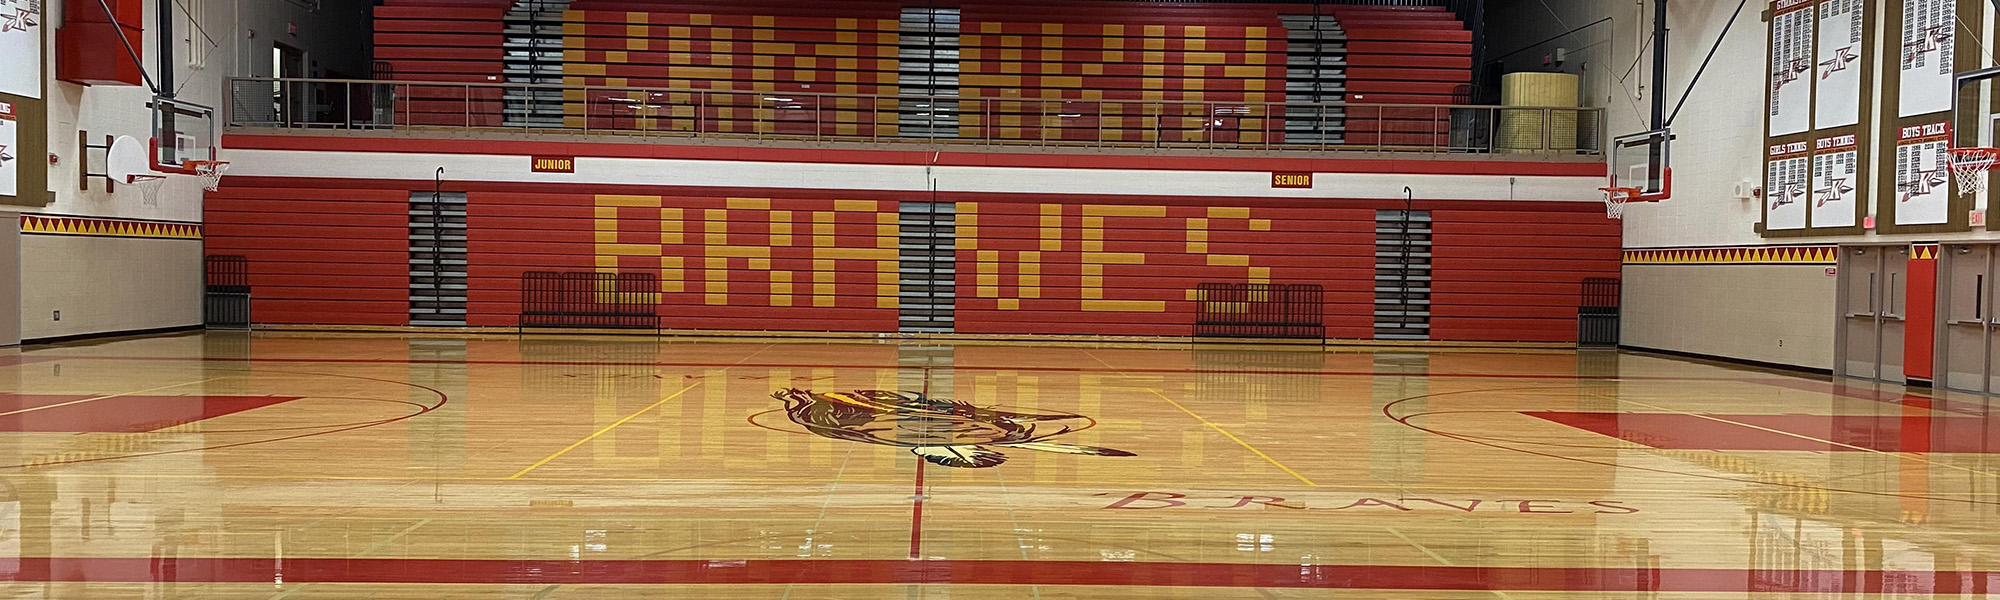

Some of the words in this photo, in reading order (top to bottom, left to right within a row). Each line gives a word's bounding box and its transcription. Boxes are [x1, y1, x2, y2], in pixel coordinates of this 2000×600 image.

[1902, 126, 1920, 139] BOYS
[1922, 123, 1945, 136] TRACK
[1816, 138, 1831, 149] BOYS
[535, 159, 571, 170] JUNIOR
[1275, 175, 1309, 186] SENIOR
[594, 194, 1271, 314] BRAVES
[1093, 491, 1640, 514] BRAVES
